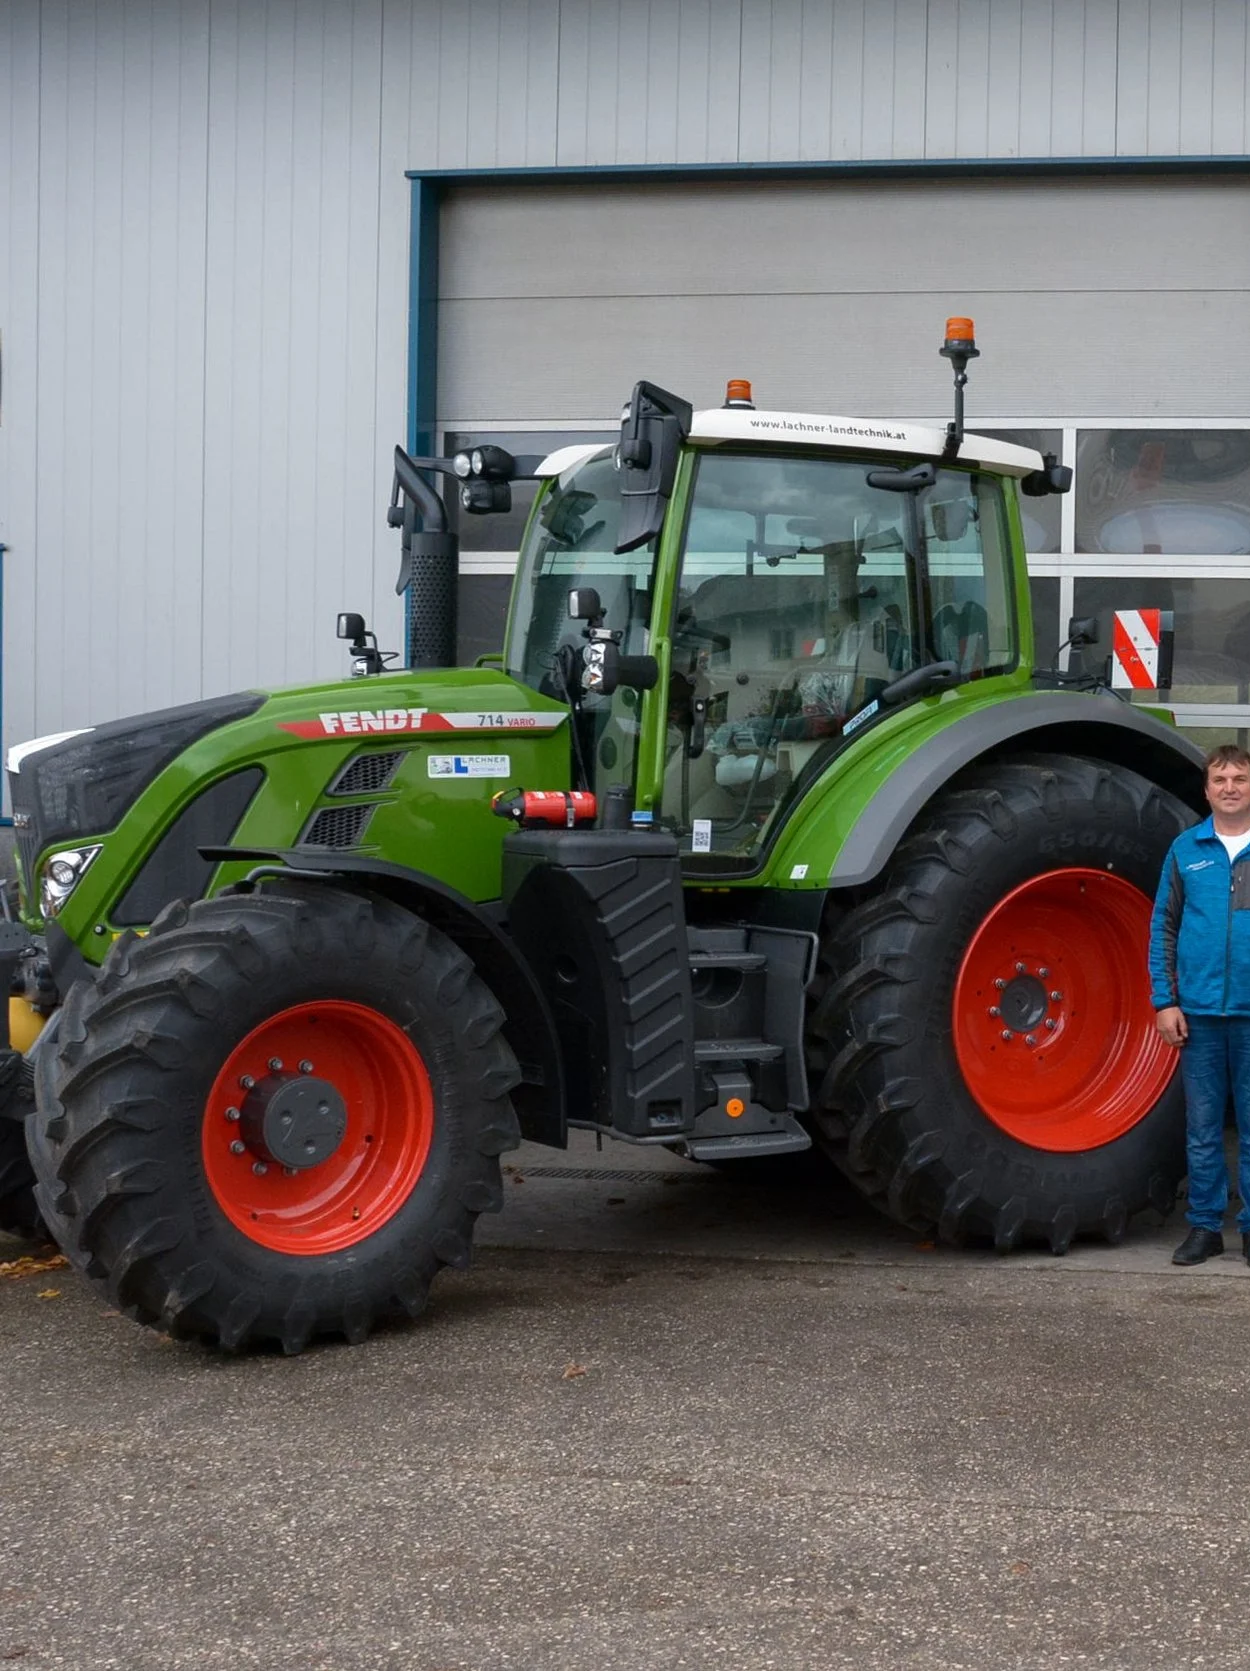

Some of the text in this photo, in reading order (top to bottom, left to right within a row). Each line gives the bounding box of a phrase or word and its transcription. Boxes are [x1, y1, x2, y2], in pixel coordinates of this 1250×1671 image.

[750, 420, 907, 440] www.lachner-landtechnik.at
[319, 708, 428, 734] FENDT
[477, 714, 536, 727] 714 VARIO
